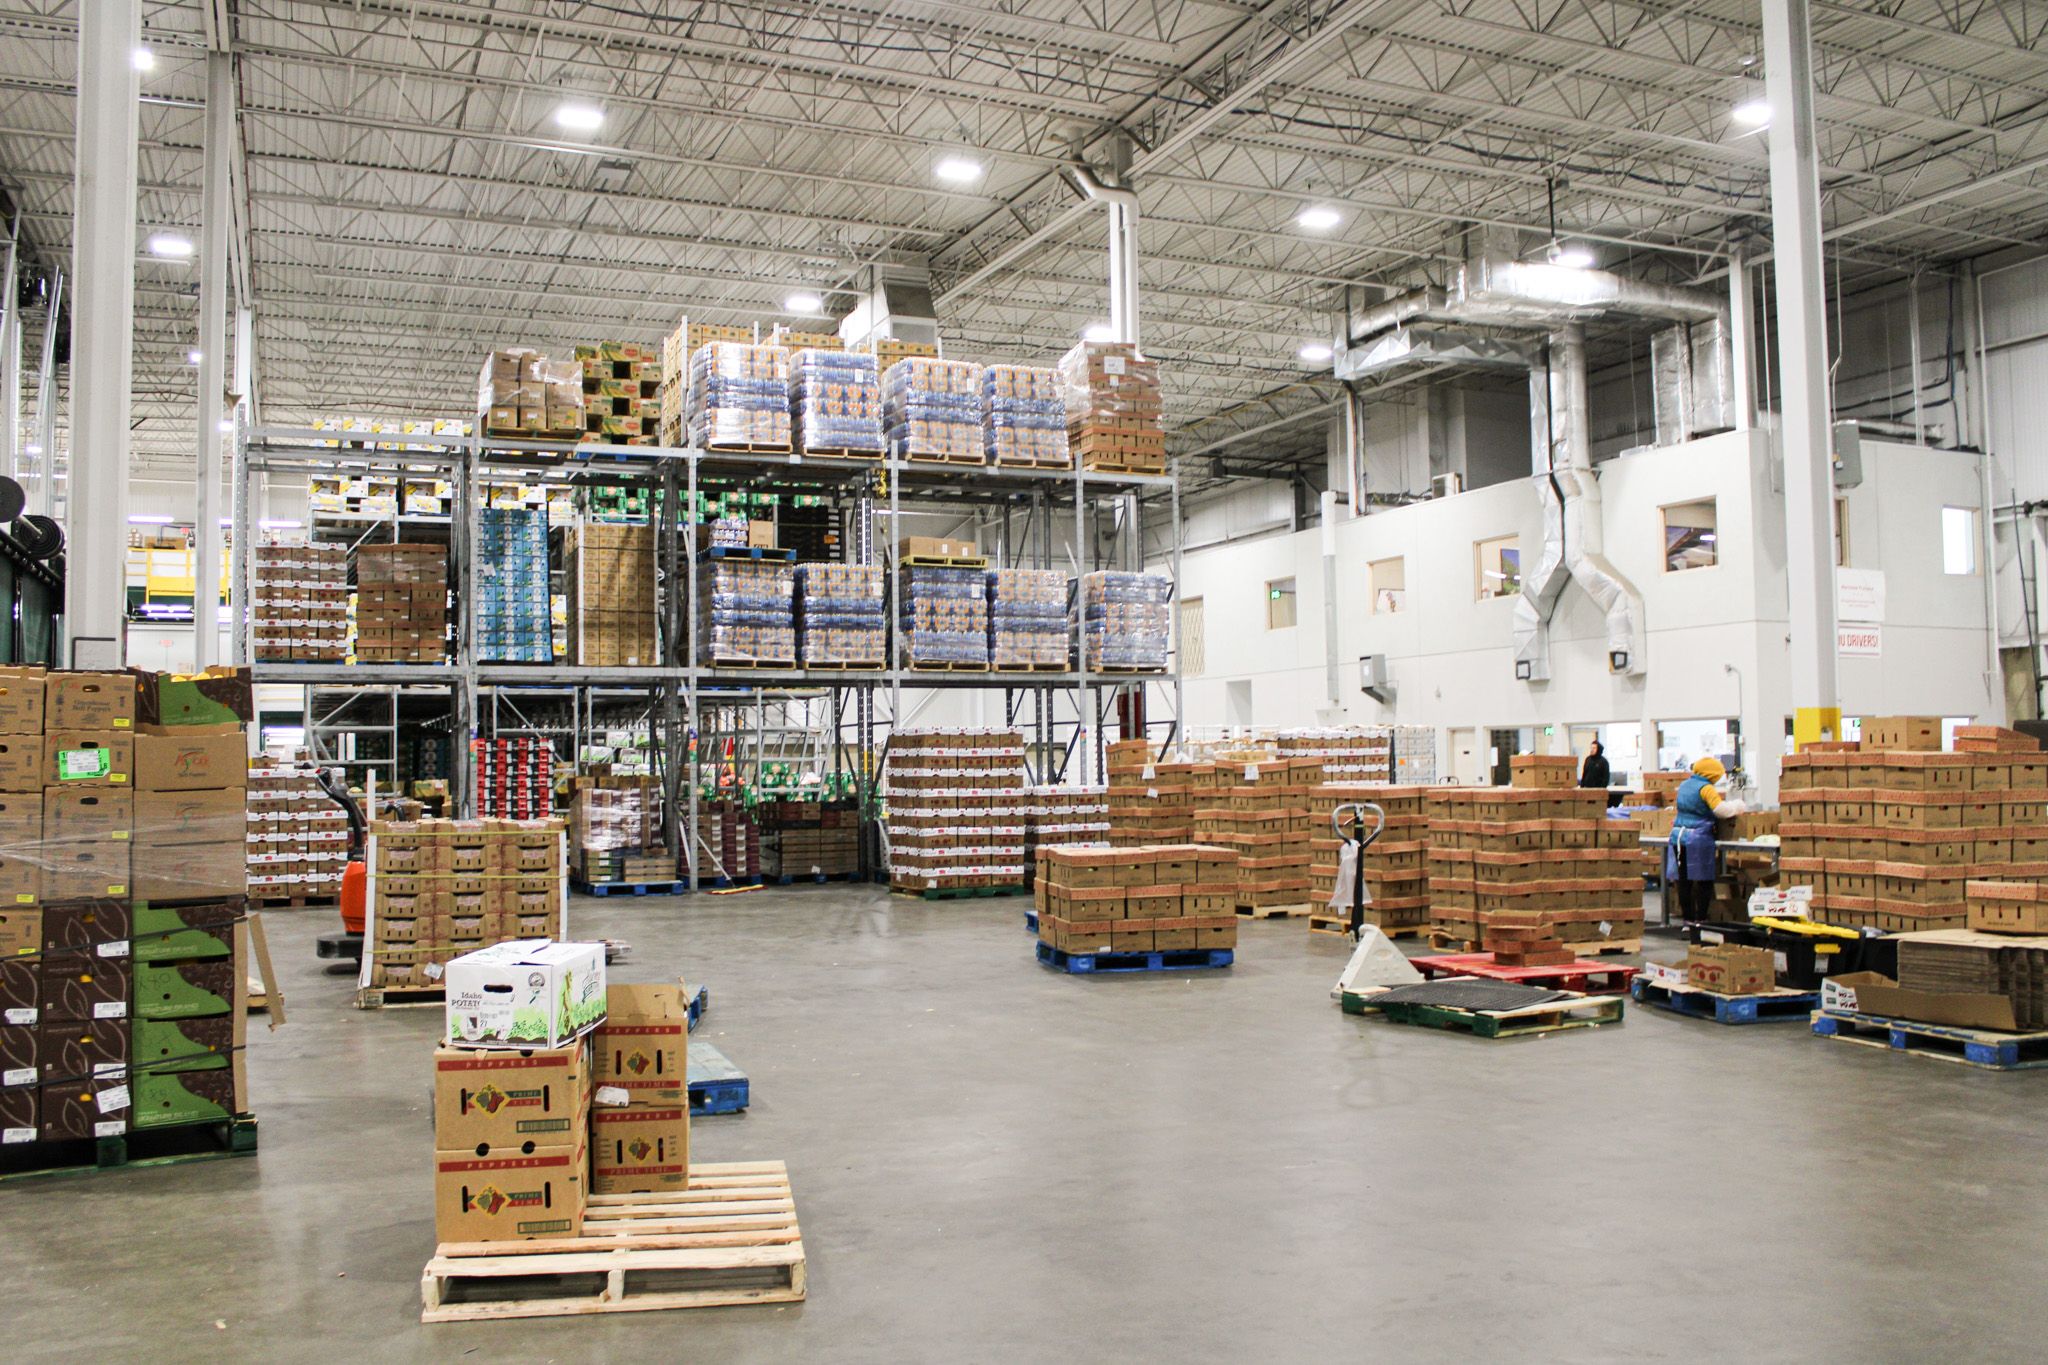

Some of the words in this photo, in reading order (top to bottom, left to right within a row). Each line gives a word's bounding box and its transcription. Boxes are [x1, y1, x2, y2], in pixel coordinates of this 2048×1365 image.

[1847, 634, 1879, 648] DRIVERS!
[461, 991, 483, 999] Idaho
[466, 1059, 538, 1068] PEPPERS
[467, 1159, 539, 1169] PEPPERS
